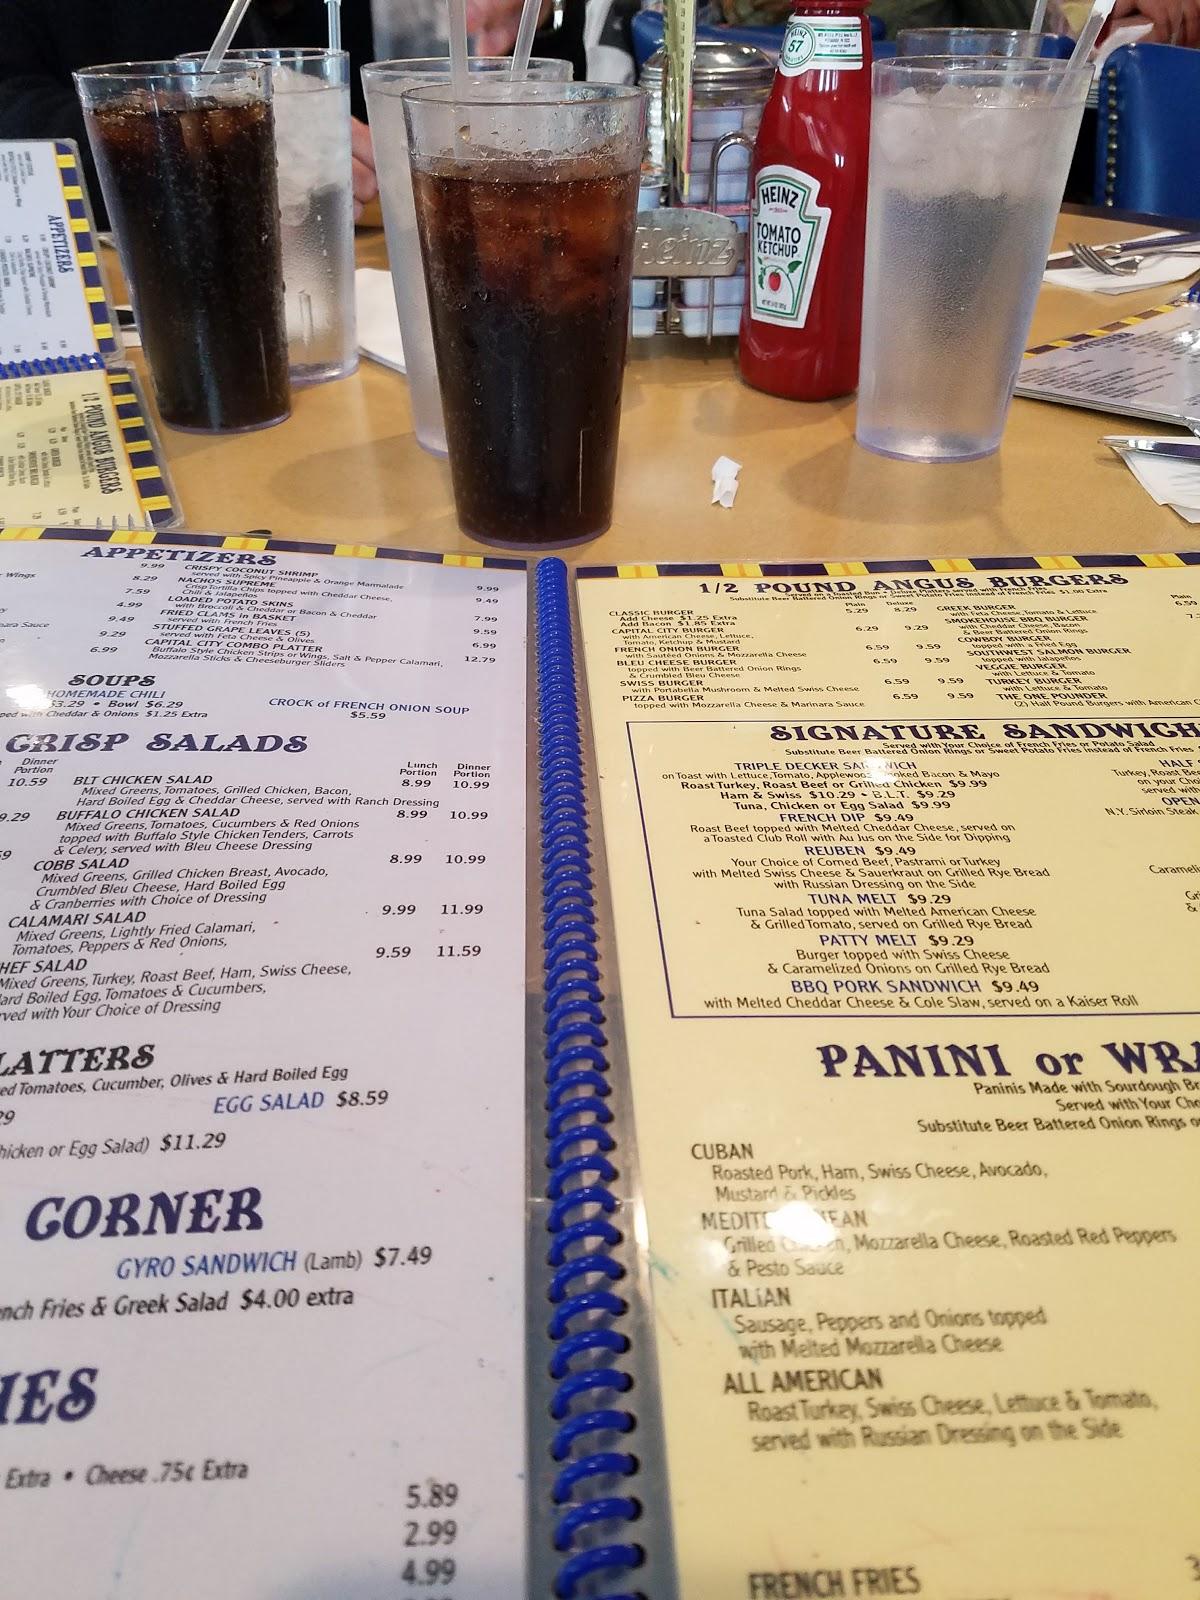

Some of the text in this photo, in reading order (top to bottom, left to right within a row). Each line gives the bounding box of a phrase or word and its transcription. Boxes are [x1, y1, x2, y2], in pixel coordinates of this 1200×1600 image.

[791, 29, 808, 39] HEINZ
[788, 40, 804, 52] 57
[761, 185, 799, 209] HEINZ
[757, 222, 801, 244] TOMATO
[48, 214, 74, 273] APPETIZERS
[757, 242, 799, 258] KETCHUP
[80, 547, 276, 565] APPETIZERS
[225, 566, 274, 575] COCONUT
[279, 570, 319, 578] SHRIMP
[226, 579, 276, 588] SUPREME
[699, 573, 1129, 594] 1/2 POUND ANGUS BURGERS
[217, 598, 258, 606] POTATO
[261, 600, 294, 608] SKINS
[197, 610, 235, 619] CLAMS
[252, 614, 296, 622] BASKET
[152, 624, 204, 632] STUFFED
[249, 628, 292, 636] LEAVES
[226, 641, 269, 650] COMBO
[272, 644, 323, 653] PLATTER
[68, 674, 156, 687] SOUPS
[269, 698, 470, 715] CROCK of FRENCH ONION SOUP
[350, 711, 386, 720] $5.59
[770, 724, 985, 741] SIGNATURE
[5, 733, 307, 753] CRISP SALADS
[400, 768, 490, 778] Portion Portion
[407, 761, 491, 771] Lunch Dinner
[7, 775, 213, 787] 10.59 BLT CHICKEN SALAD
[401, 779, 490, 789] 8.99 10.99
[56, 808, 240, 820] BUFFALO CHICKEN SALAD
[396, 810, 488, 820] 8.99 10.99
[780, 813, 914, 822] FRENCH DIP $9.49
[805, 846, 916, 856] REUBEN $9.49
[34, 858, 130, 871] COBB SALAD
[389, 854, 486, 864] 8.99 10.99
[808, 893, 952, 905] TUNA MELT $9.29
[382, 904, 483, 915] 9.99 11.99
[8, 912, 146, 928] CALAMARI SALAD
[819, 934, 974, 947] PATTY MELT $9.29
[375, 946, 481, 958] 9.59 11.59
[792, 980, 1039, 995] BBQ PORK SANDWICH $9.49
[704, 995, 1139, 1009] with Melted Cheddar Cheese & Cole Slaw, served on a Kaiser Roll
[816, 1043, 1084, 1078] PANINI or
[213, 1090, 389, 1115] EGG SALAD $8.59
[160, 1133, 226, 1153] $11.29
[691, 1144, 754, 1160] CUBAN
[712, 1162, 1047, 1181] Roasted Pork, Ham, Swiss Cheese, Avocado,
[25, 1187, 263, 1241] CORNER
[116, 1246, 432, 1280] GYRO SANDWICH (Lamb) $7.49
[114, 1289, 353, 1317] Greek Salad $4.00 extra
[712, 1288, 791, 1309] ITALIAN
[723, 1367, 883, 1394] ALL AMERICAN
[406, 1483, 458, 1509] 5.89
[404, 1520, 457, 1546] 2.99
[402, 1558, 456, 1586] 4.99
[748, 1567, 920, 1599] FRENCH FRIES
